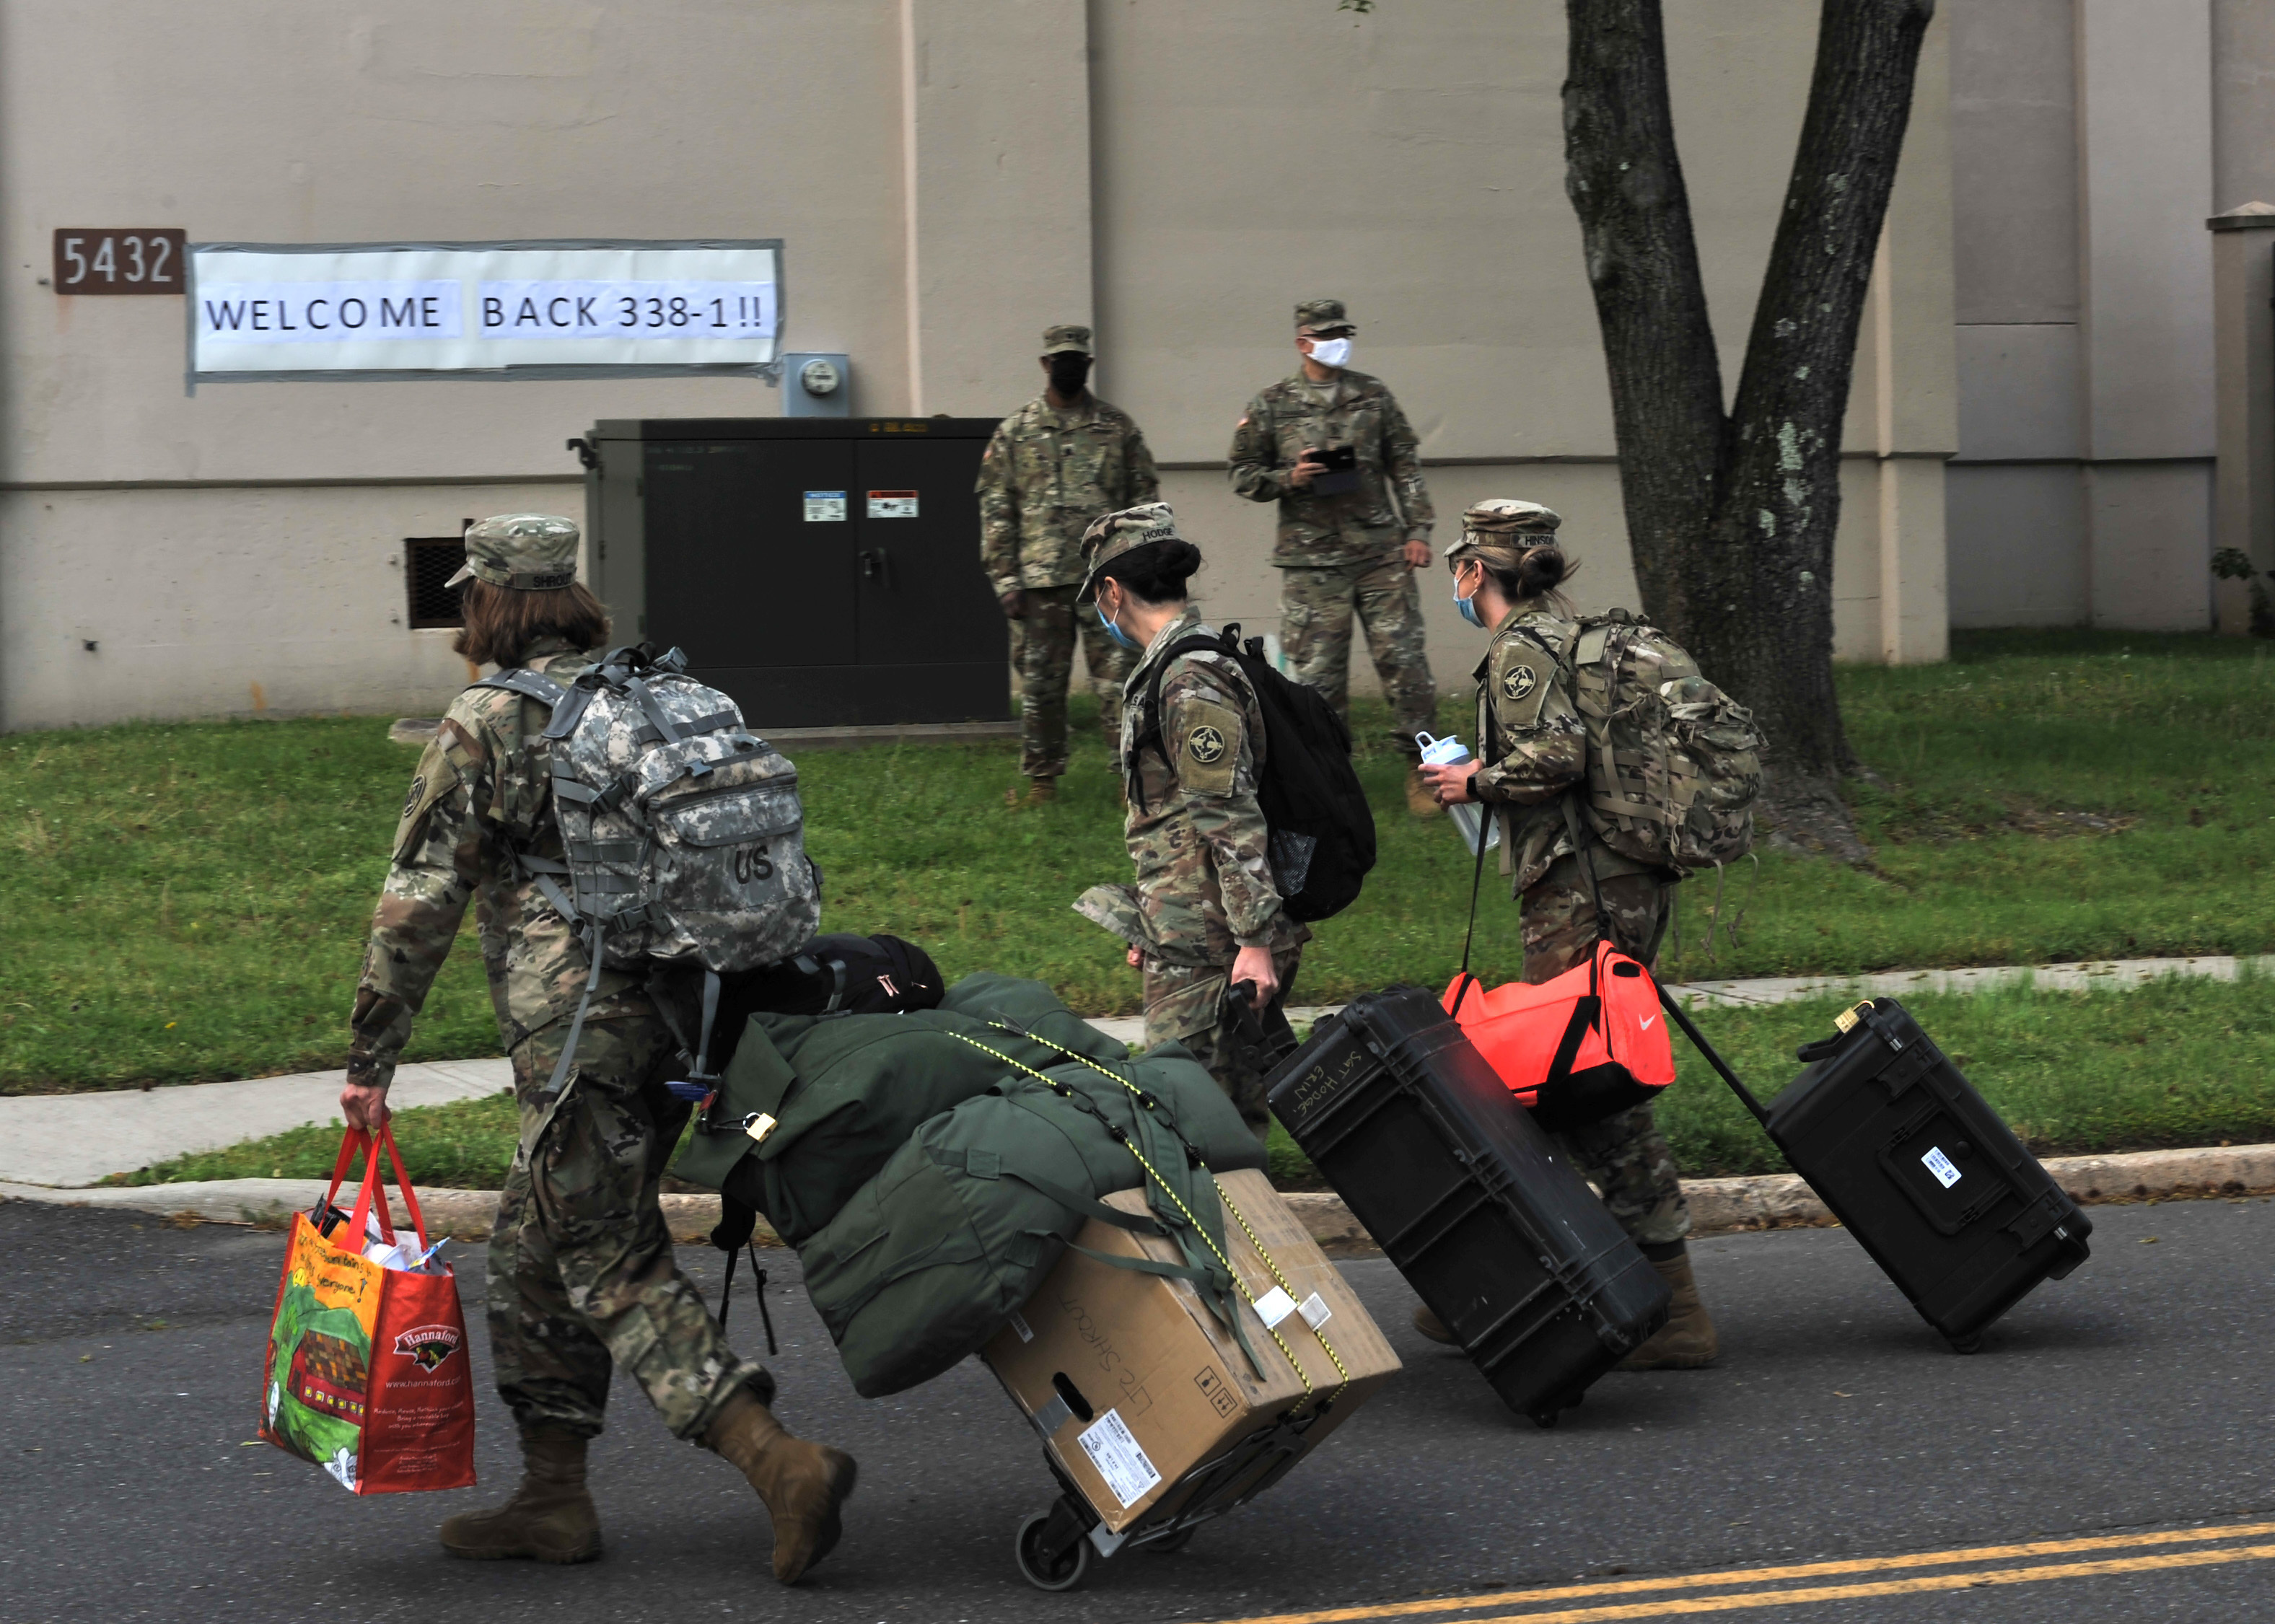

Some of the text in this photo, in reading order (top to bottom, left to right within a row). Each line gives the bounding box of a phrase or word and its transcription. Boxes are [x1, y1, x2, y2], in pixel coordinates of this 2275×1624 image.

[63, 236, 172, 284] 5432
[206, 296, 762, 330] WELCOME BACK 338-1!!
[1142, 527, 1174, 541] HODGE
[532, 571, 572, 587] SHROUT
[735, 845, 773, 885] US
[1338, 1050, 1362, 1079] SGT
[1294, 1065, 1325, 1100] ERIN
[404, 1329, 459, 1346] Hannaford
[1058, 1294, 1121, 1372] SHROUT
